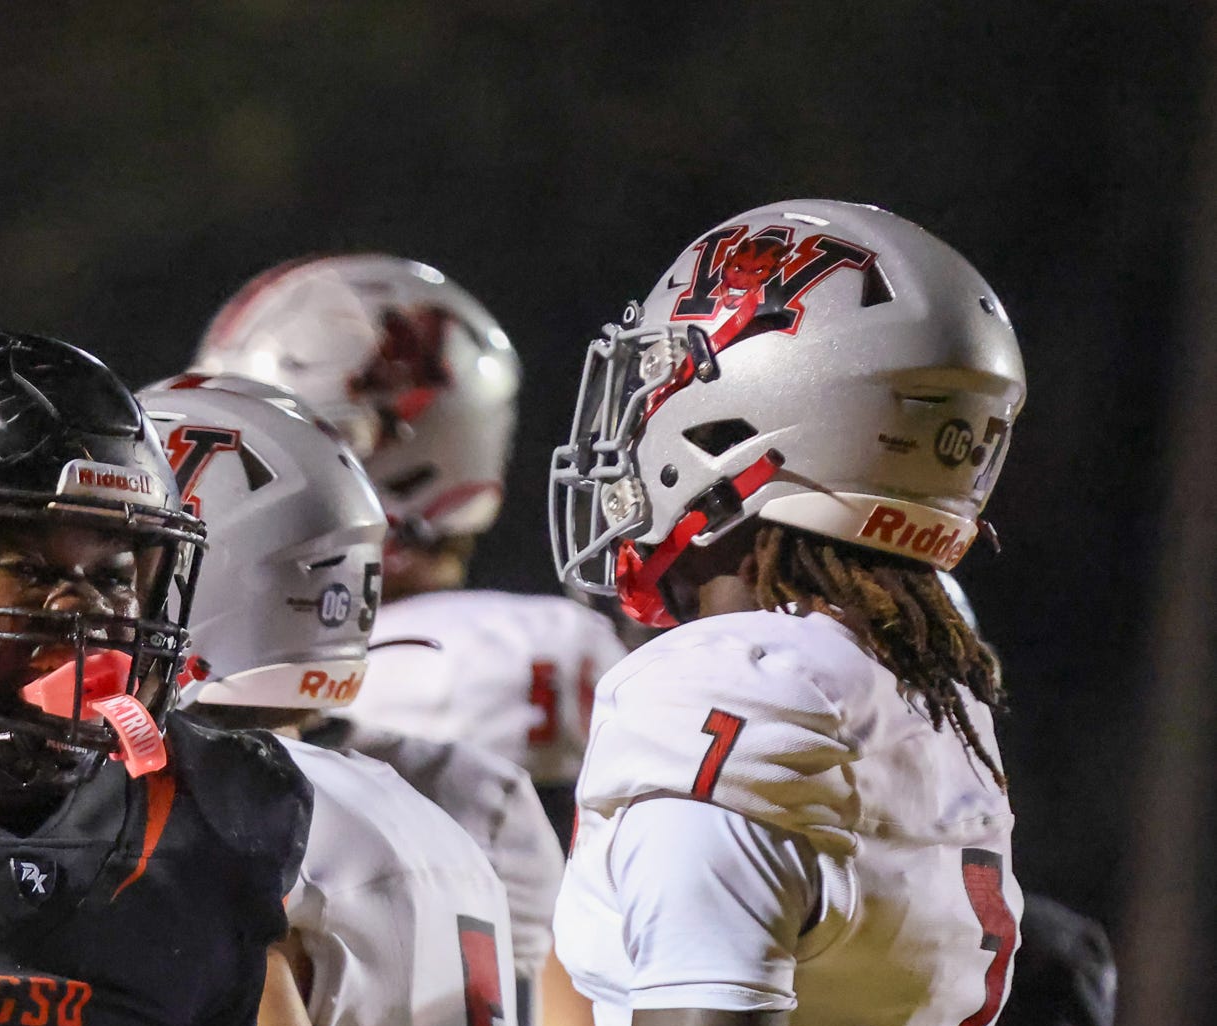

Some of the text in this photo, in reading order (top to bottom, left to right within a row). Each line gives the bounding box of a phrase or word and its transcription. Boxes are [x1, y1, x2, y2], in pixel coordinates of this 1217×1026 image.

[937, 422, 973, 463] OG
[78, 466, 152, 494] Riddell
[321, 588, 349, 622] OG
